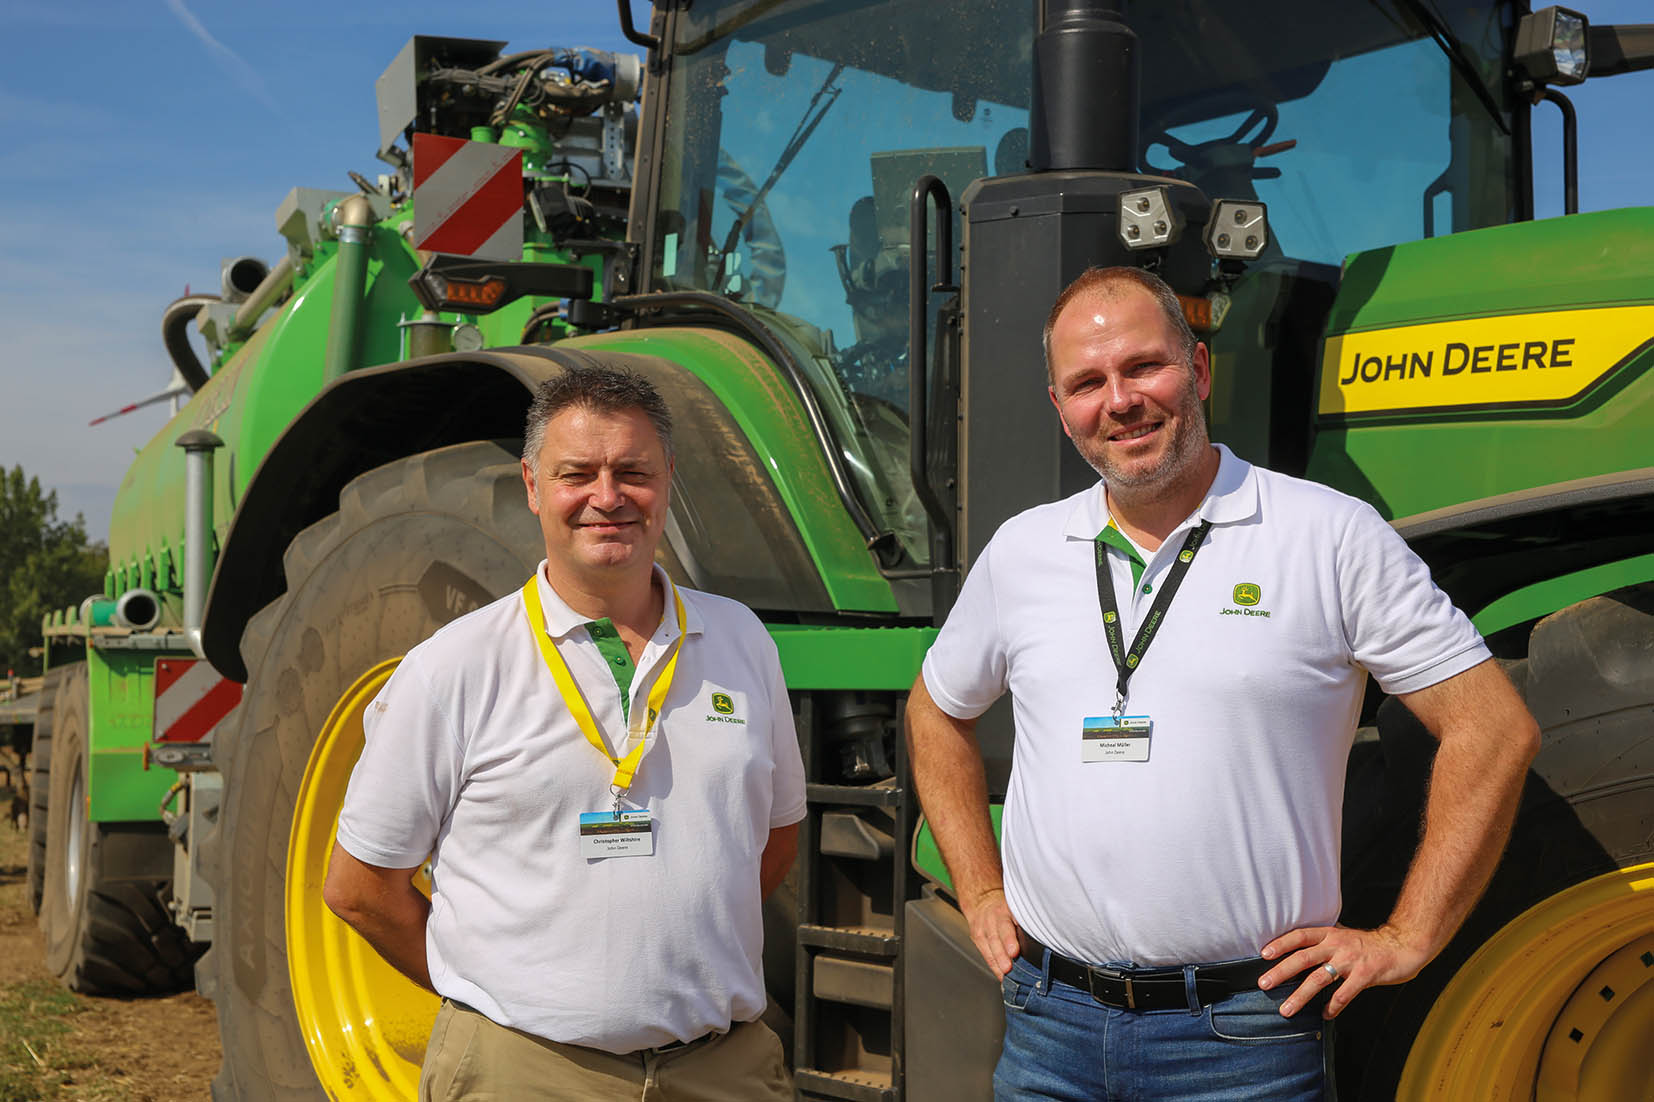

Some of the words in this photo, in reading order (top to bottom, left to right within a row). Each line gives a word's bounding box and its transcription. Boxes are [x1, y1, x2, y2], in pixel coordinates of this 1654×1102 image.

[1341, 351, 1434, 385] JOHN
[1442, 338, 1576, 376] DEERE
[1219, 607, 1243, 616] JOHN
[1243, 608, 1271, 618] DEERE
[1136, 633, 1150, 654] JOHN
[1144, 610, 1161, 634] DEERE
[705, 714, 724, 722] JOHN
[724, 716, 746, 725] DEERE
